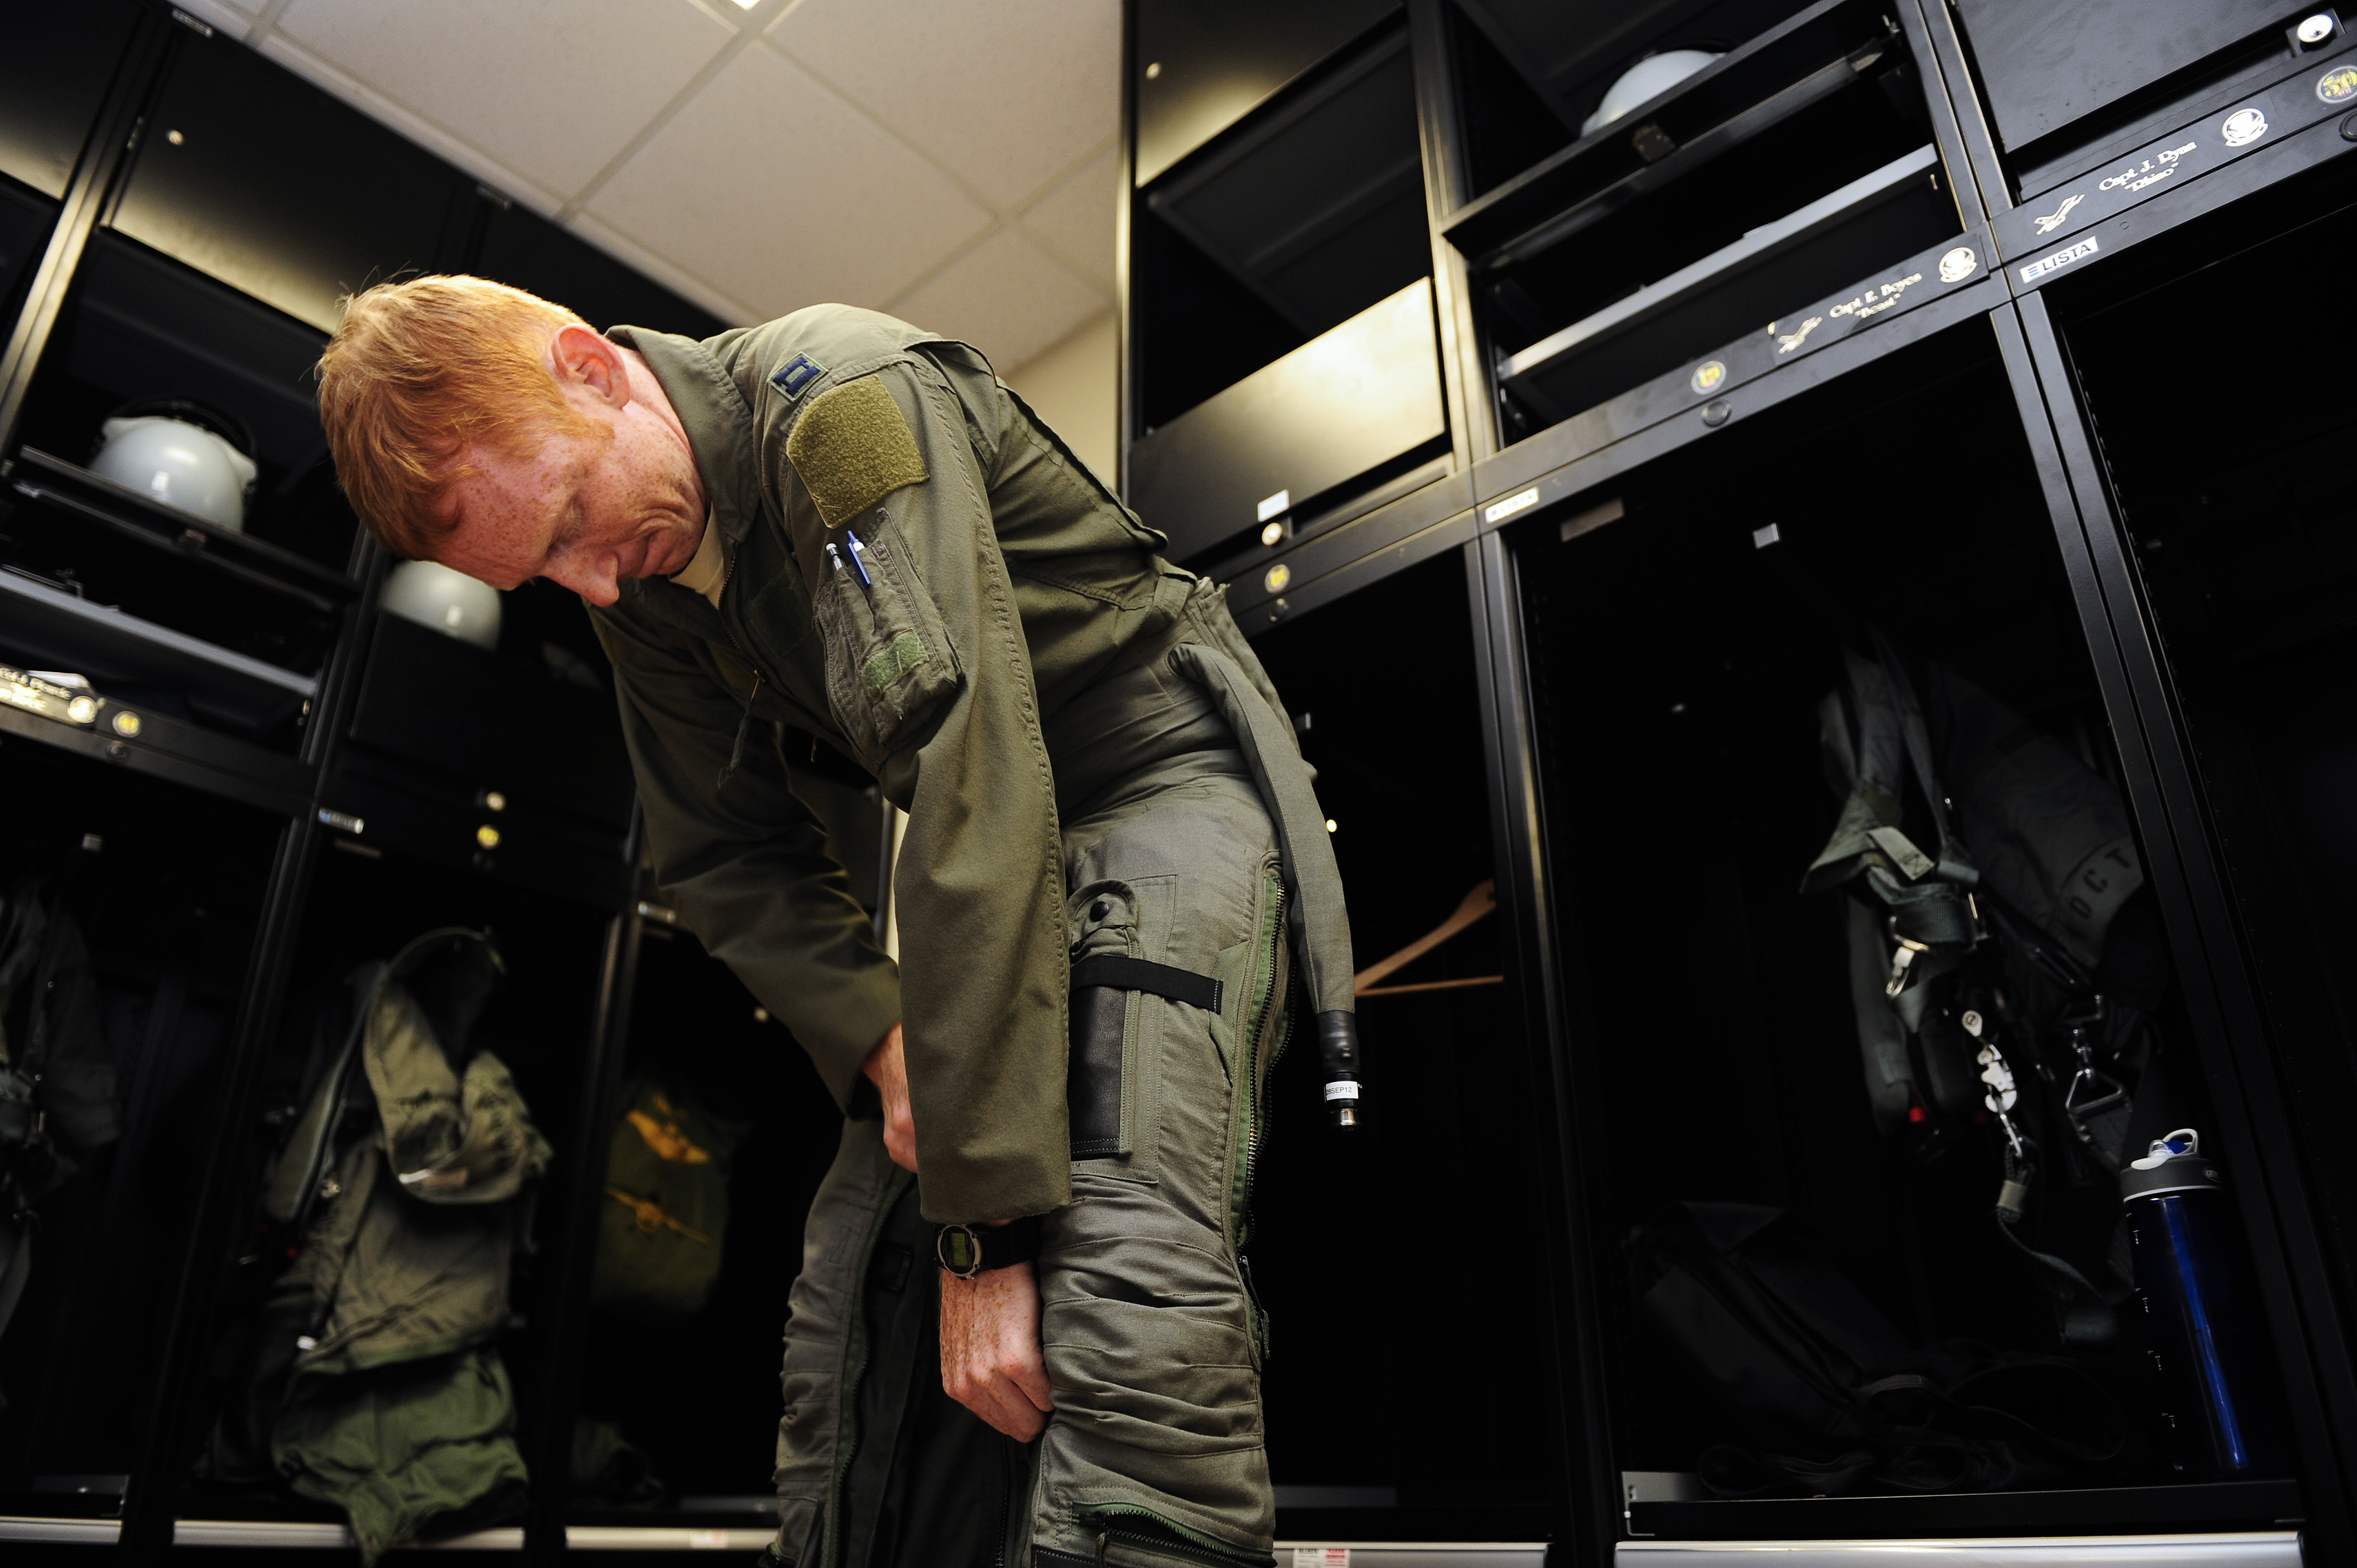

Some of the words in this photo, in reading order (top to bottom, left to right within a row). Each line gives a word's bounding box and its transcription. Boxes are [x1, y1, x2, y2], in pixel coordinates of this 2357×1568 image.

[2099, 168, 2138, 190] Capt
[2140, 159, 2155, 173] J.
[2157, 141, 2198, 164] Ryan
[2042, 244, 2091, 271] LISTA
[1829, 297, 1864, 318] Capt
